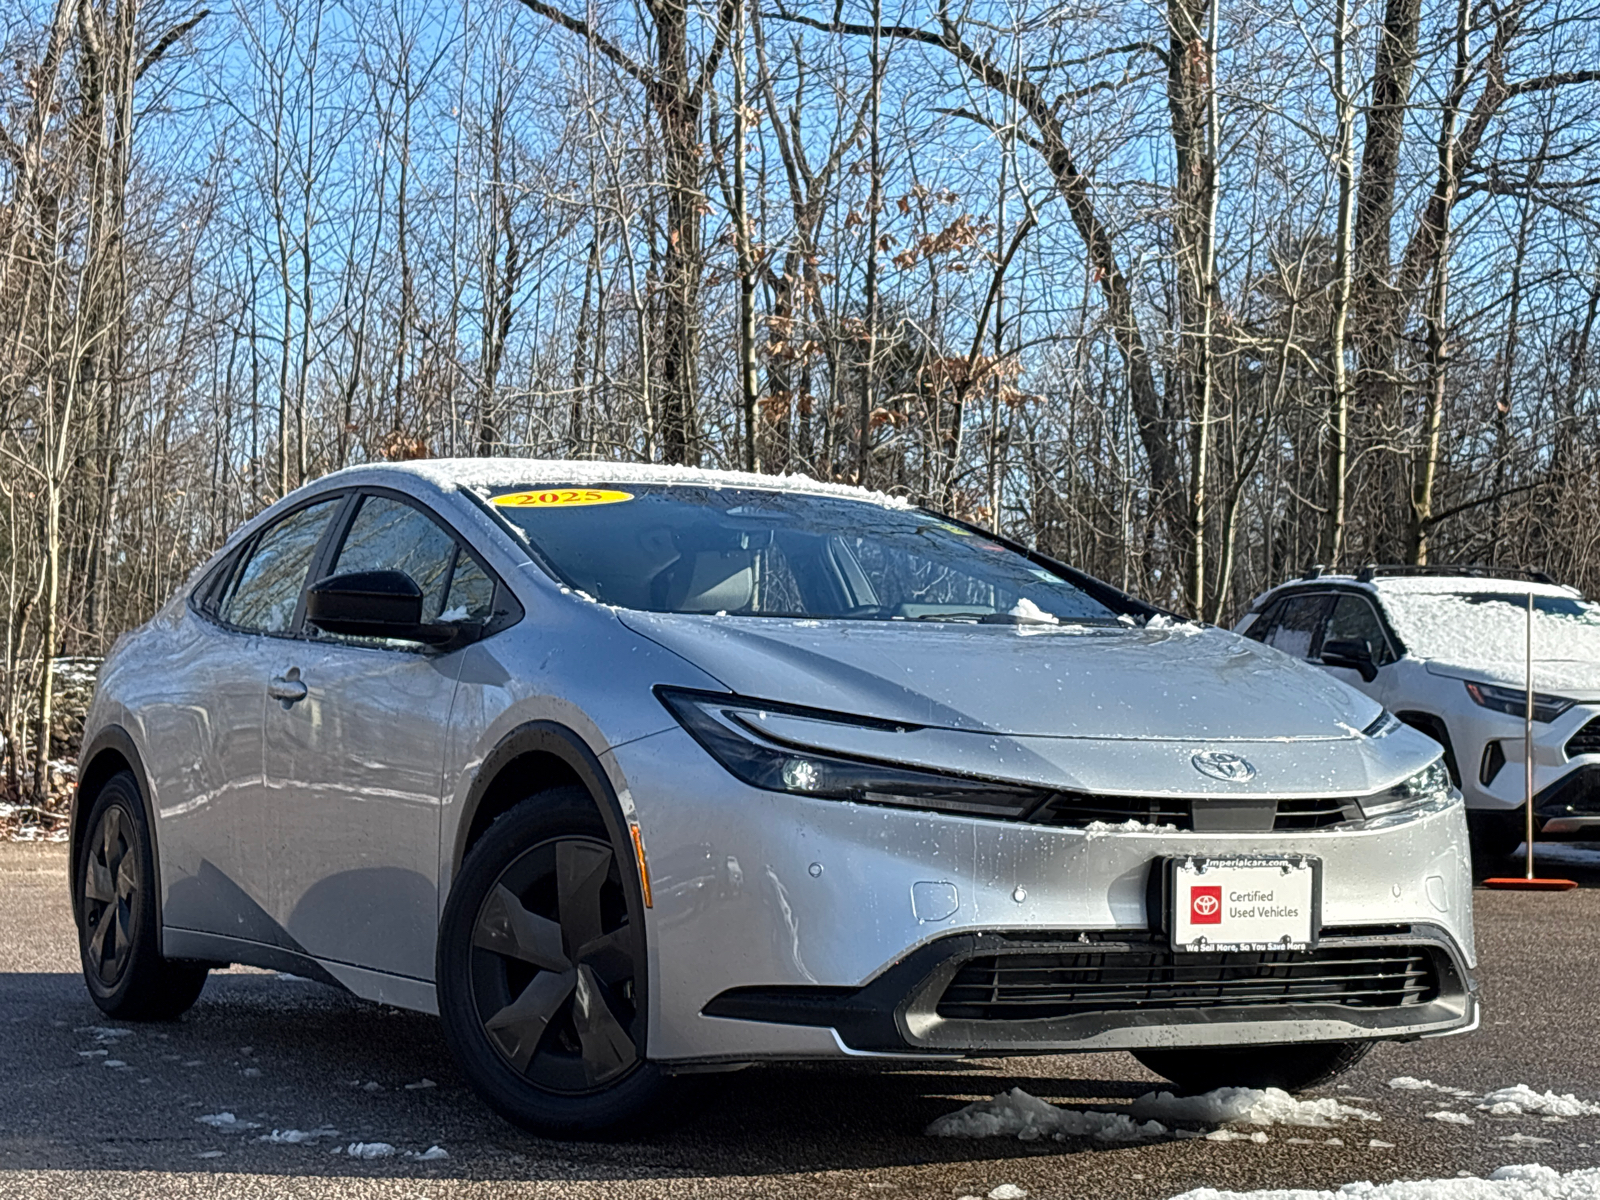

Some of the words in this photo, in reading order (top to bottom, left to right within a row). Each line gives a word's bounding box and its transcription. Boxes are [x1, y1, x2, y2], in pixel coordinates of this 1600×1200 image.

[515, 491, 602, 505] 2025
[1206, 858, 1289, 868] Imperialcars.com
[1229, 891, 1274, 902] Certified
[1229, 906, 1255, 918] Used
[1257, 906, 1299, 917] Vehicles
[1186, 944, 1199, 952] We
[1200, 944, 1215, 952] Sell
[1216, 944, 1239, 952] More,
[1240, 943, 1250, 951] So
[1251, 943, 1266, 951] You
[1267, 943, 1286, 951] Save
[1286, 942, 1306, 951] More
